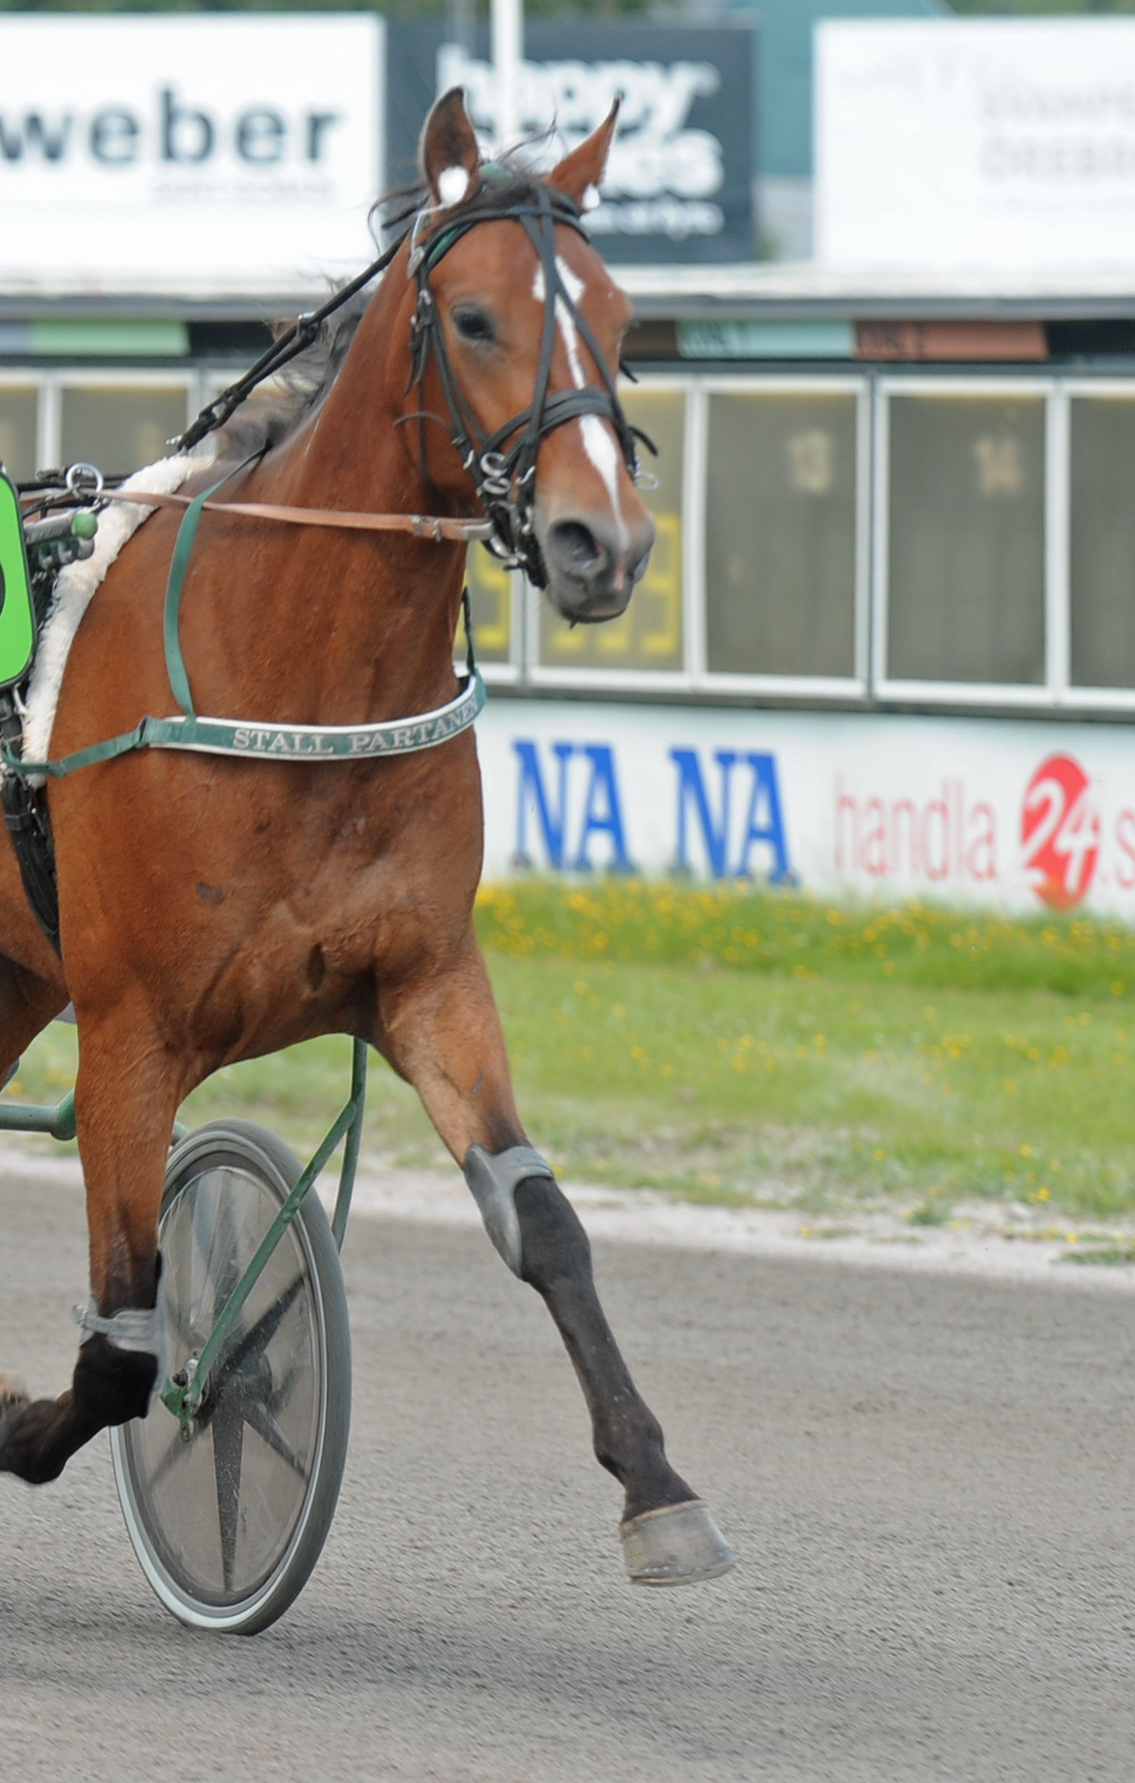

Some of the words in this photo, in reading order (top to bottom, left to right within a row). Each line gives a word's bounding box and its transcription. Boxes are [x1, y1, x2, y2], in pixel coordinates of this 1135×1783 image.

[232, 729, 334, 755] STALL
[511, 739, 638, 876] NA
[668, 746, 800, 888] NA
[833, 768, 998, 883] handla
